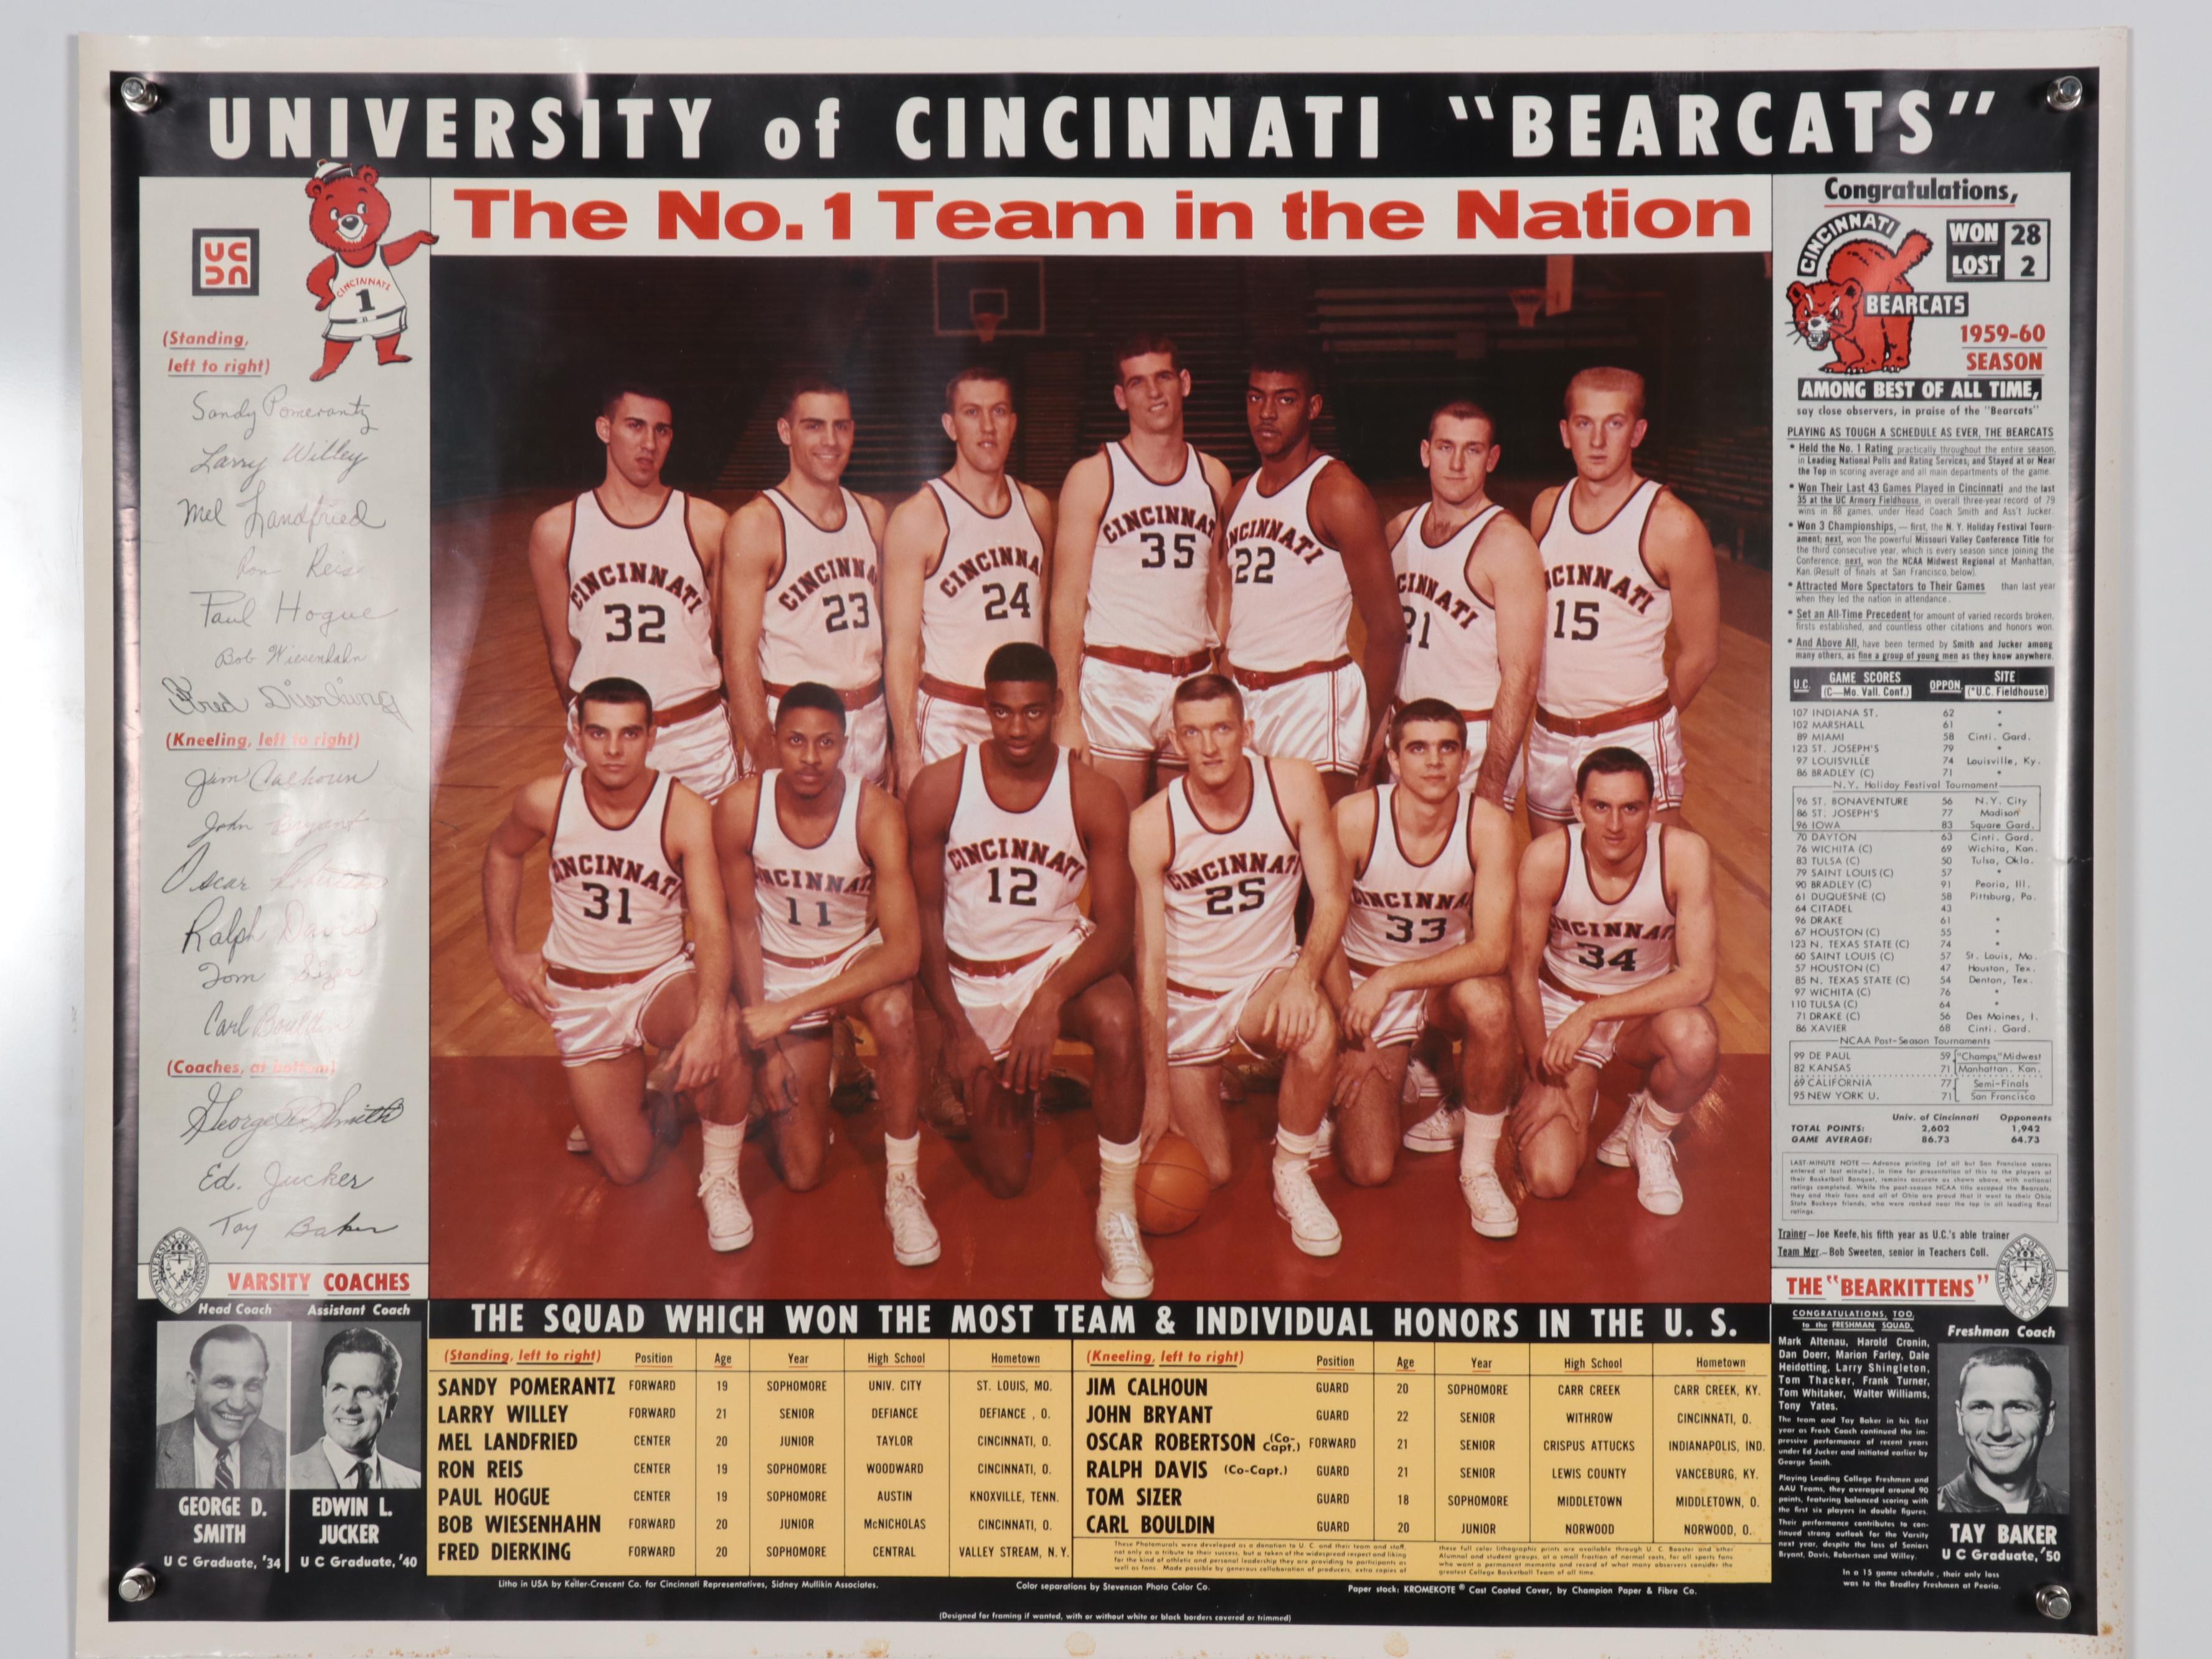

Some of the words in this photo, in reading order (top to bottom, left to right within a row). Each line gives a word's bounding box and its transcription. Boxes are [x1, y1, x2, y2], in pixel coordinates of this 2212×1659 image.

[210, 97, 711, 159] UNIVERSITY
[765, 98, 839, 159] of
[896, 97, 1378, 159] CINCINNATI
[1825, 177, 2018, 203] Congratulations,
[454, 189, 627, 240] The
[878, 191, 1143, 239] Team
[1176, 191, 1252, 239] in
[1282, 191, 1424, 240] the
[1457, 189, 1750, 239] Nation
[1949, 223, 1998, 243] WON
[2011, 224, 2041, 245] 28
[1799, 212, 1896, 275] CINCINNATI
[1952, 255, 2001, 275] LOST
[2021, 256, 2035, 276] 2
[337, 276, 390, 298] CINCINNATI
[356, 289, 375, 312] 1
[1866, 295, 1964, 313] BEARCATS
[163, 331, 248, 347] (Standing,
[1961, 324, 2045, 343] 1959-60
[168, 358, 195, 372] left
[202, 360, 217, 372] to
[225, 359, 270, 375] right)
[1967, 352, 2042, 371] SEASON
[1802, 381, 1866, 398] AMONG
[1874, 381, 1915, 399] BEST
[1922, 381, 1944, 399] OF
[1951, 381, 1982, 398] ALL
[1989, 381, 2038, 399] TIME,
[1797, 409, 1813, 417] say
[1819, 405, 1841, 415] close
[1846, 405, 1896, 416] observers,
[1902, 407, 1910, 415] in
[1916, 407, 1945, 417] praise
[1950, 405, 1959, 415] of
[1965, 405, 1979, 415] the
[1985, 405, 2038, 415] "Bearcats"
[1141, 532, 1196, 569] 35
[1234, 546, 1275, 584] 22
[569, 562, 702, 614] CINCINNATI
[982, 582, 1031, 620] 24
[189, 590, 256, 628] Paul
[275, 590, 399, 637] Hogue
[823, 593, 869, 633] 23
[1554, 600, 1599, 640] 15
[604, 603, 665, 643] 32
[1829, 672, 1856, 683] GAME
[1864, 671, 1901, 683] SCORES
[1995, 671, 2015, 683] SITE
[1794, 709, 1808, 717] 107
[1813, 709, 1859, 717] INDIANA
[1864, 709, 1878, 717] ST.
[1794, 721, 1808, 729] 102
[1813, 721, 1864, 729] MARSHALL
[988, 868, 1037, 905] 12
[582, 883, 632, 924] 31
[1206, 879, 1265, 915] 25
[785, 897, 831, 927] 11
[1386, 914, 1447, 943] 33
[1577, 942, 1638, 973] 34
[198, 1162, 242, 1191] Ed.
[258, 1161, 374, 1209] Jucker
[285, 1212, 399, 1238] Baker
[228, 1273, 310, 1291] VARSITY
[324, 1273, 410, 1292] COACHES
[1787, 1277, 1822, 1295] THE
[199, 1304, 230, 1314] Head
[236, 1304, 272, 1315] Coach
[308, 1304, 365, 1316] Assistant
[373, 1304, 410, 1316] Coach
[472, 1304, 522, 1331] THE
[545, 1304, 644, 1333] SQUAD
[665, 1305, 763, 1333] WHICH
[786, 1305, 857, 1333] WON
[879, 1305, 930, 1333] THE
[952, 1305, 1033, 1333] MOST
[1055, 1305, 1135, 1333] TEAM
[1156, 1307, 1175, 1333] &
[1197, 1307, 1373, 1335] INDIVIDUAL
[1395, 1308, 1518, 1337] HONORS
[1540, 1310, 1569, 1337] IN
[1591, 1309, 1643, 1336] THE
[1666, 1309, 1693, 1336] U.
[1712, 1308, 1736, 1336] S.
[1948, 1325, 2009, 1336] Freshman
[2018, 1326, 2055, 1338] Coach
[636, 1353, 672, 1363] Position
[715, 1353, 731, 1366] Age
[788, 1353, 808, 1363] Year
[868, 1353, 888, 1365] High
[895, 1353, 925, 1363] School
[992, 1353, 1039, 1363] Hometown
[438, 1378, 497, 1396] SANDY
[511, 1377, 615, 1395] POMERANTZ
[630, 1380, 675, 1390] FORWARD
[717, 1381, 727, 1391] 19
[767, 1381, 826, 1391] SOPHOMORE
[869, 1381, 894, 1391] UNIV.
[901, 1381, 921, 1390] CITY
[977, 1381, 990, 1391] ST.
[998, 1381, 1028, 1392] LOUIS,
[1034, 1381, 1051, 1391] MO.
[1087, 1378, 1115, 1395] JIM
[1128, 1378, 1207, 1396] CALHOUN
[439, 1406, 494, 1423] LARRY
[507, 1405, 568, 1422] WILLEY
[1087, 1406, 1130, 1423] JOHN
[1144, 1406, 1212, 1423] BRYANT
[438, 1433, 472, 1450] MEL
[485, 1432, 577, 1450] LANDFRIED
[1087, 1433, 1142, 1450] OSCAR
[1156, 1433, 1255, 1451] ROBERTSON
[438, 1460, 474, 1478] RON
[488, 1460, 522, 1478] REIS
[1087, 1460, 1141, 1478] RALPH
[1155, 1461, 1207, 1478] DAVIS
[179, 1496, 240, 1516] GEORGE
[252, 1497, 267, 1516] D.
[313, 1497, 368, 1516] EDWIN
[380, 1497, 392, 1516] L.
[438, 1488, 482, 1506] PAUL
[495, 1488, 549, 1505] HOGUE
[1087, 1488, 1124, 1505] TOM
[1137, 1488, 1181, 1506] SIZER
[194, 1524, 245, 1543] SMITH
[438, 1516, 472, 1533] BOB
[485, 1515, 600, 1533] WIESENHAHN
[1087, 1515, 1128, 1533] CARL
[1141, 1516, 1214, 1534] BOULDIN
[1950, 1523, 1985, 1543] TAY
[1998, 1524, 2057, 1544] BAKER
[319, 1524, 379, 1544] JUCKER
[438, 1543, 479, 1561] FRED
[492, 1543, 570, 1560] DIERKING
[1016, 1581, 1037, 1589] Color
[1041, 1582, 1086, 1591] separations
[1090, 1582, 1099, 1592] by
[1104, 1582, 1142, 1590] Stevenson
[1172, 1582, 1193, 1590] Color
[1197, 1582, 1210, 1590] Co.
